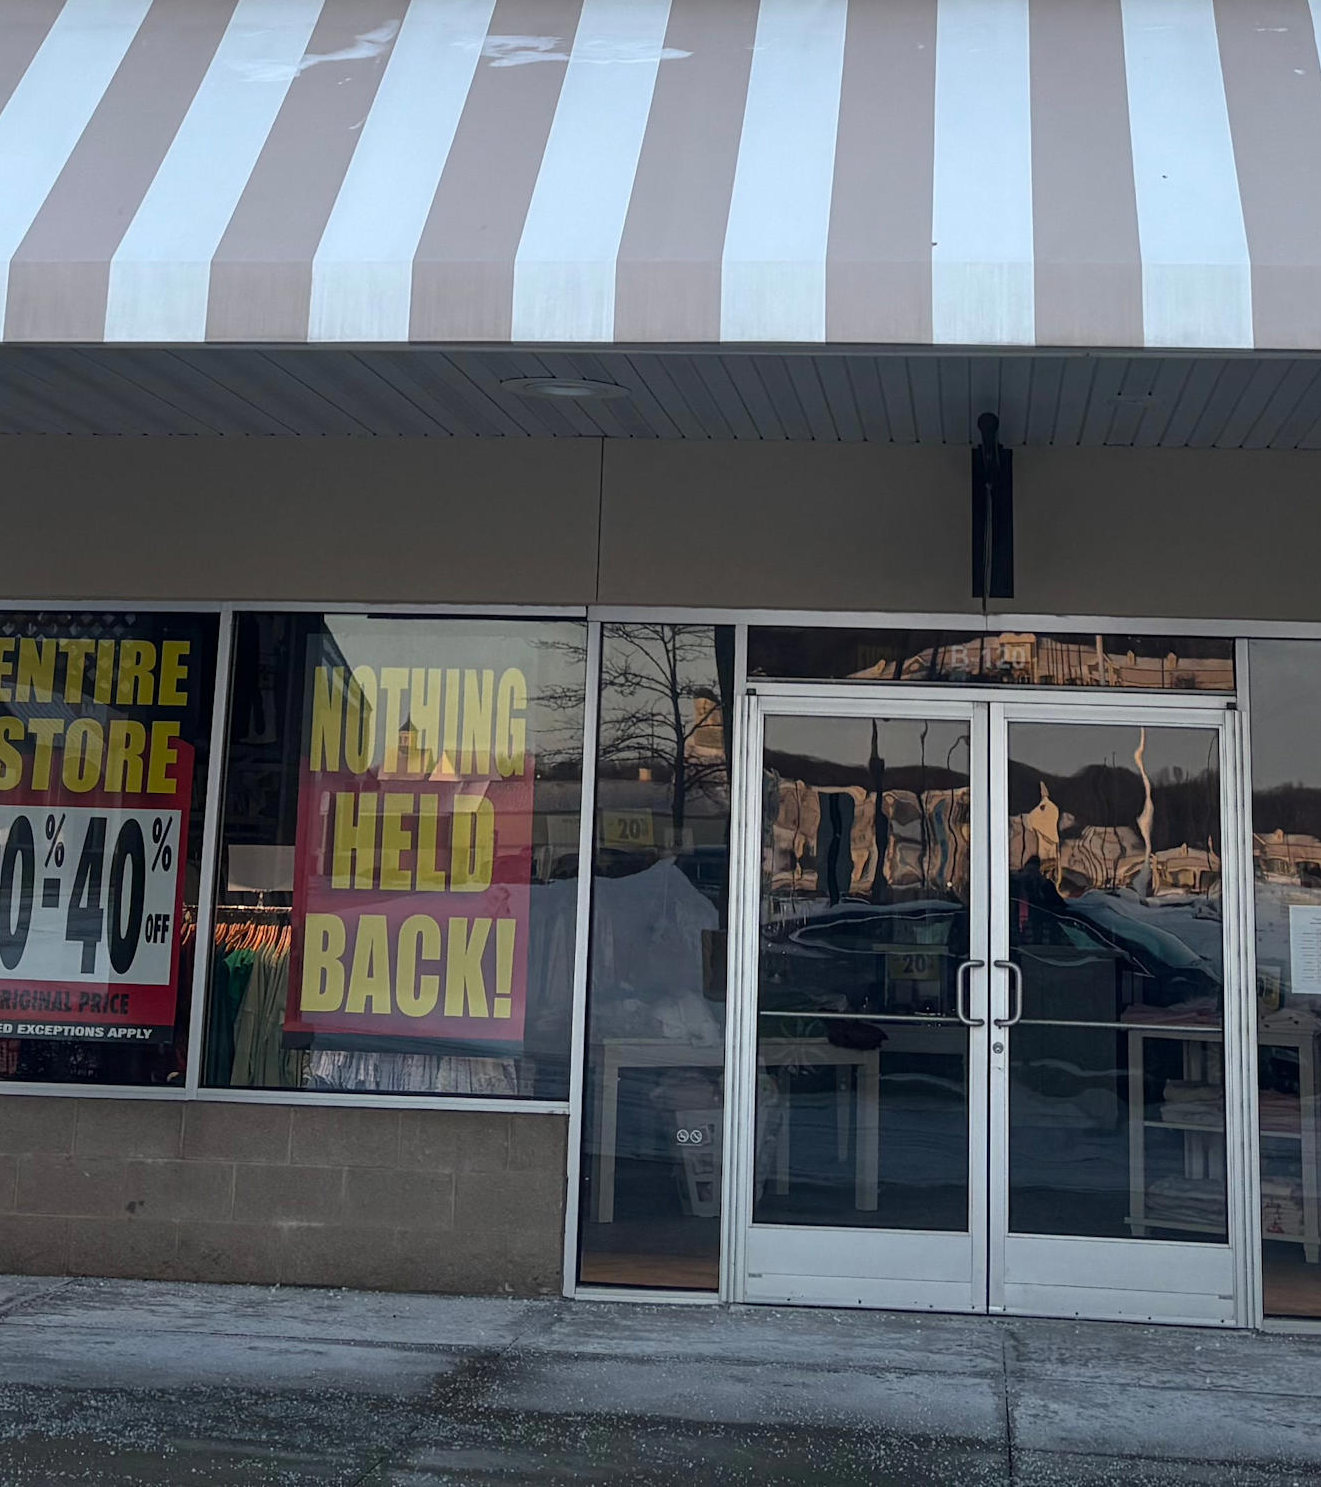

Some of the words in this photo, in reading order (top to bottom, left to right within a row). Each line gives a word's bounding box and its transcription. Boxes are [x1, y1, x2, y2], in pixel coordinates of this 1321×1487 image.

[309, 665, 527, 778] NOTHING
[331, 791, 496, 893] HELD
[145, 913, 170, 944] OFF
[300, 912, 517, 1019] BACK!
[17, 1024, 105, 1038] EXCEPTIONS
[107, 1027, 153, 1040] APPLY
[80, 991, 131, 1014] PRICE
